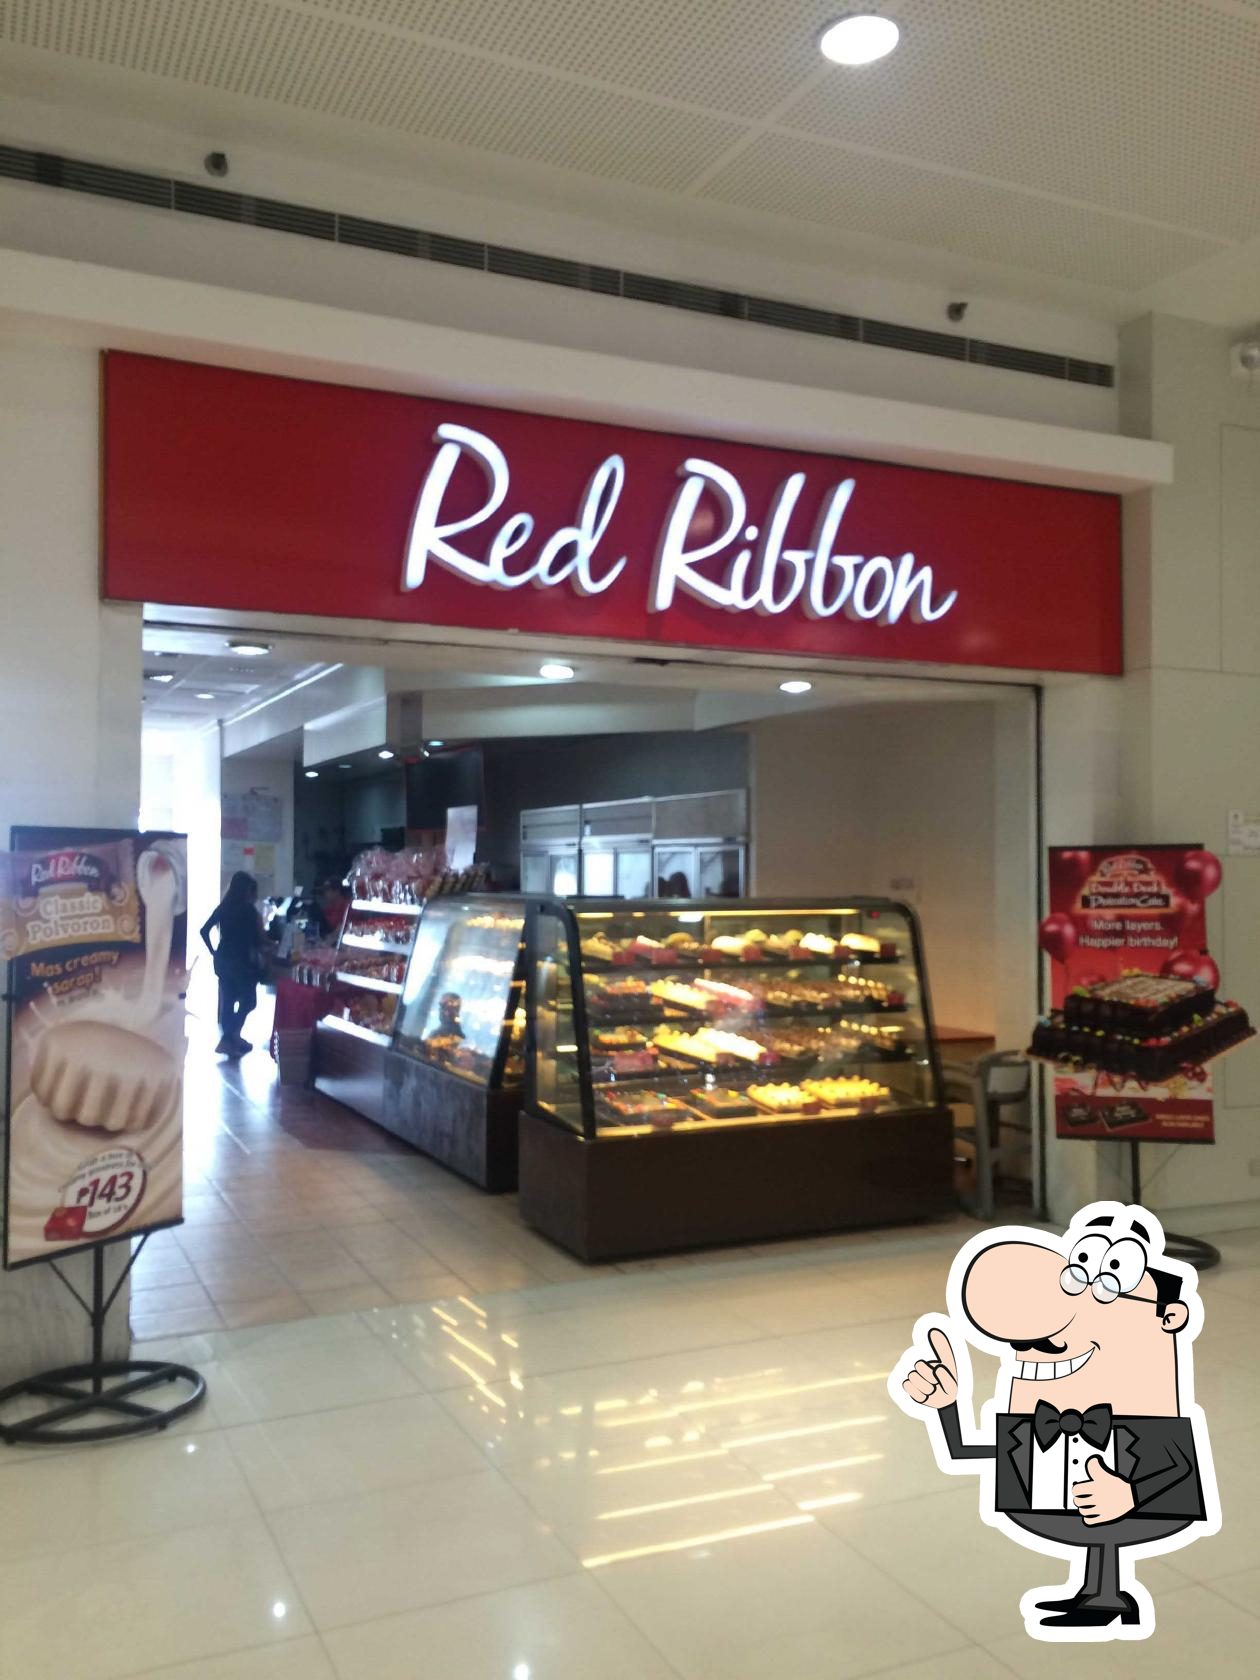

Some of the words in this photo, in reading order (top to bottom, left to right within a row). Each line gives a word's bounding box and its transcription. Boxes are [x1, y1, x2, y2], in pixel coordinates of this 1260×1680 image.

[403, 423, 627, 596] Red
[650, 457, 958, 626] Ribbon
[41, 893, 102, 918] Classic
[28, 916, 114, 943] Polvoron
[1093, 919, 1122, 931] More
[1079, 935, 1125, 949] Happier
[1127, 935, 1178, 950] birthday!
[31, 962, 63, 977] Mas
[65, 951, 120, 972] creamy
[52, 965, 102, 994] sarap!
